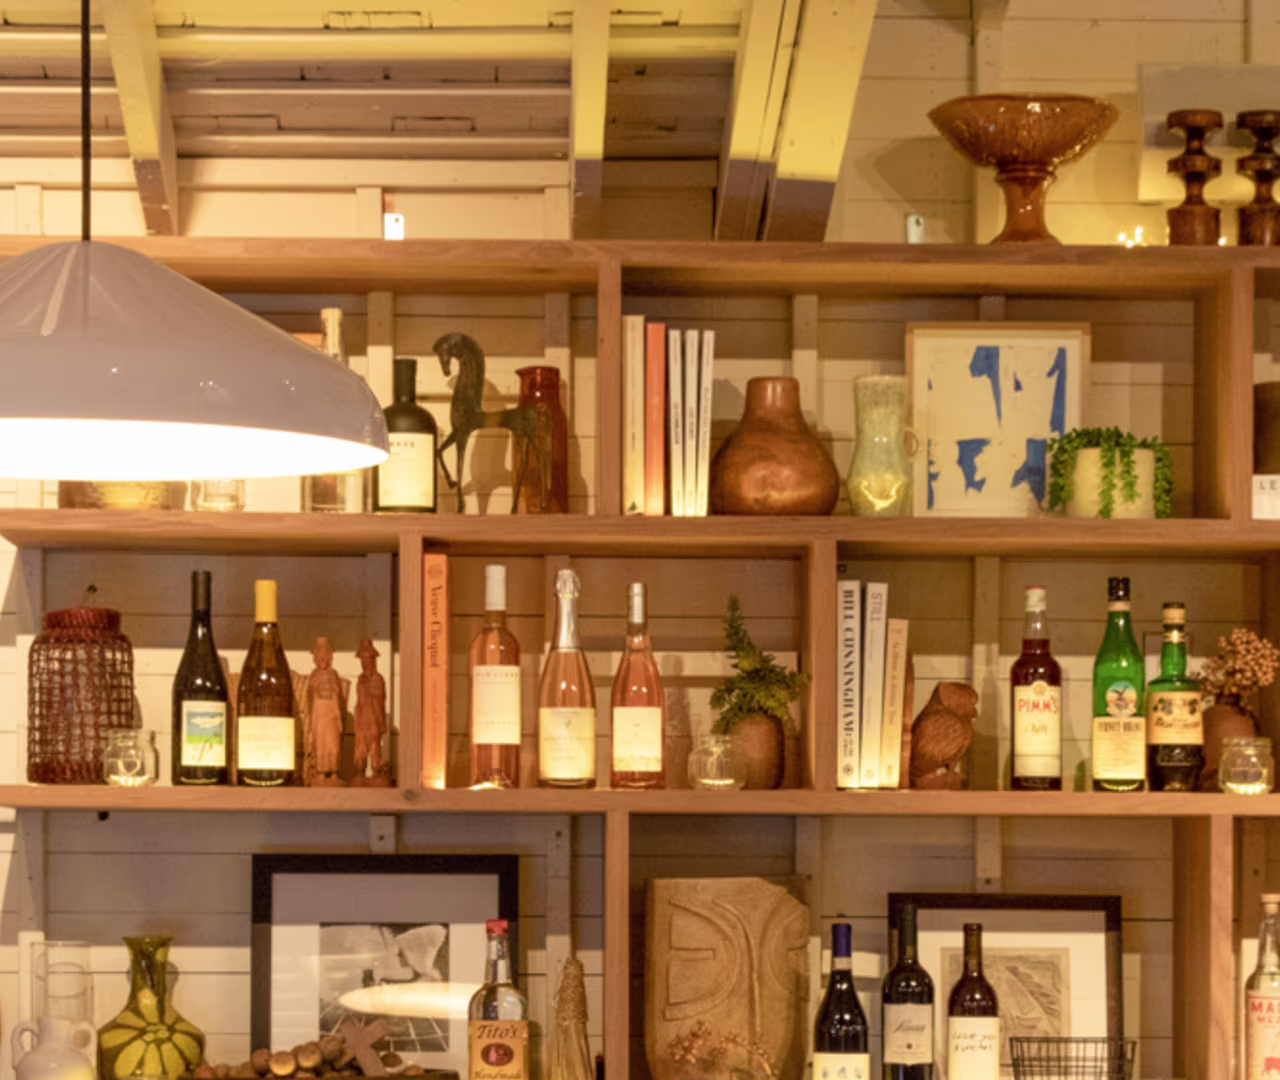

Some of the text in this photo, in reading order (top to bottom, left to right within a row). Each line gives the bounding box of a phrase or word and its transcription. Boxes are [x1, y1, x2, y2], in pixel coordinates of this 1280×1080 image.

[842, 589, 855, 620] BILL
[870, 592, 883, 623] STILL
[1018, 695, 1058, 715] PIMM'S
[477, 1024, 518, 1039] Tito's
